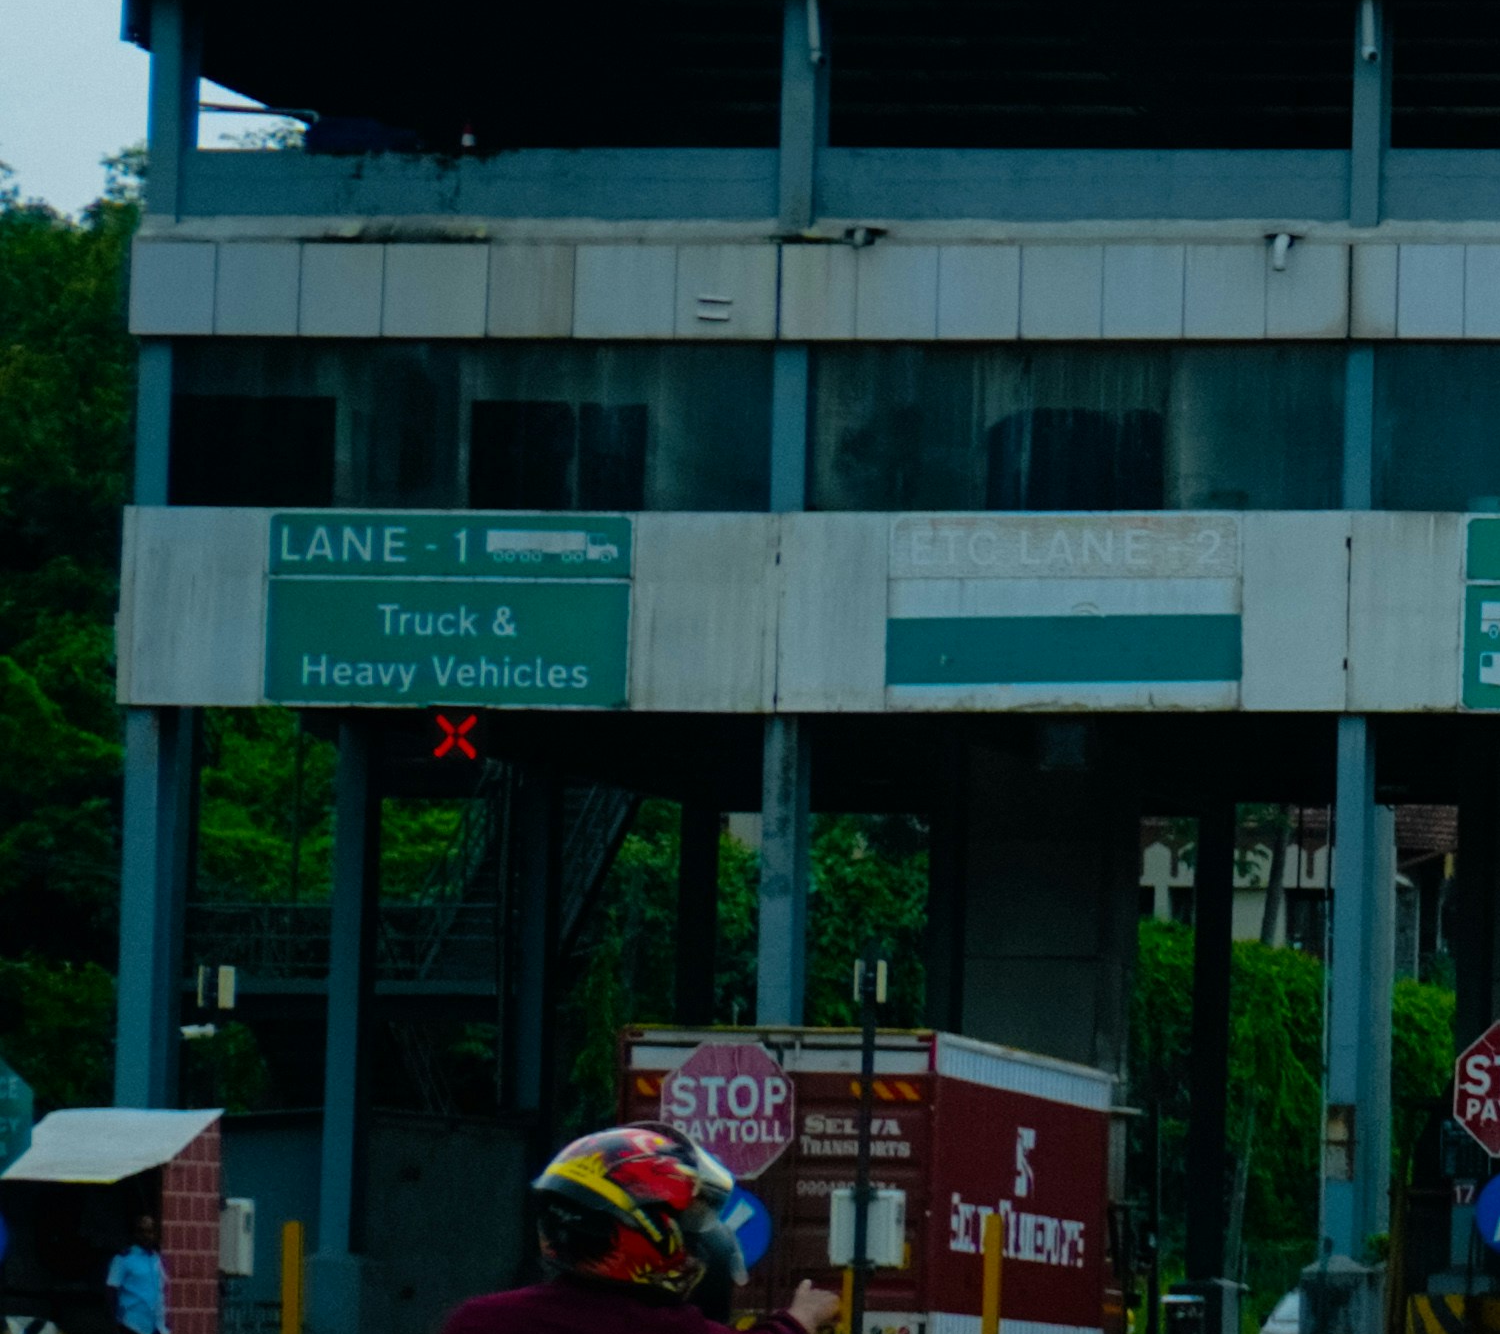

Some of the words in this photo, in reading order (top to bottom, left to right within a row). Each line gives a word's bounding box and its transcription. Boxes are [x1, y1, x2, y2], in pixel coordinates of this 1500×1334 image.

[280, 525, 407, 563] LANE
[454, 528, 467, 563] 1
[910, 529, 998, 565] ETC
[1020, 529, 1149, 565] LANE
[1187, 529, 1221, 565] 2
[378, 603, 477, 637] Truck
[492, 606, 517, 637] &
[301, 654, 416, 693] Heavy
[433, 655, 589, 688] Vehicles
[671, 1075, 787, 1117] STOP
[724, 1120, 785, 1143] TOLL
[1455, 1185, 1475, 1203] 17
